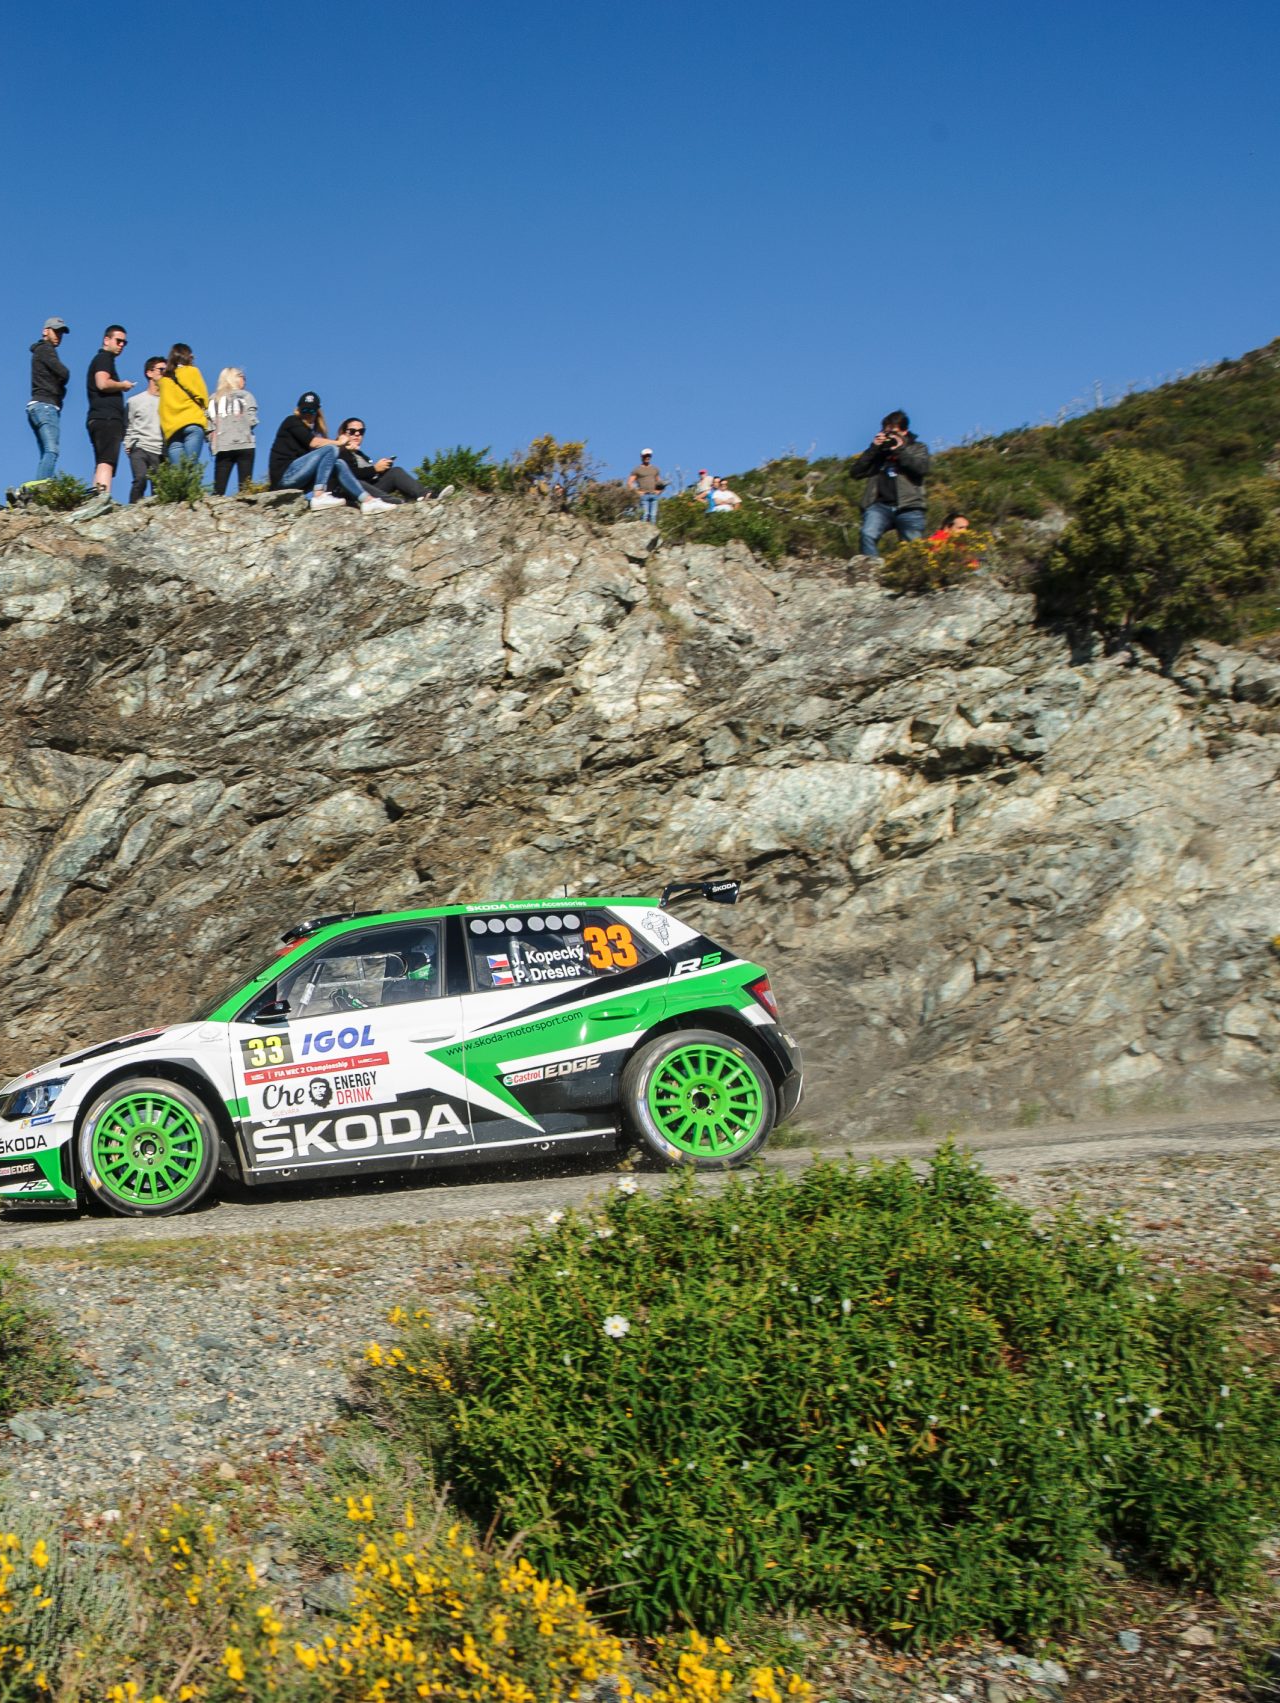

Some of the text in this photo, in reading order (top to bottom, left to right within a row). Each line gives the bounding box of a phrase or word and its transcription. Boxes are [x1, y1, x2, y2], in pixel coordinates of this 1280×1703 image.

[542, 900, 587, 908] Accessories
[512, 944, 585, 966] J. Kopecký
[583, 924, 638, 969] 33
[515, 963, 582, 983] P. Dresler
[673, 951, 722, 976] R5
[301, 1024, 375, 1056] IGOL
[446, 1010, 584, 1057] www.skoda-motorsport.com
[248, 1035, 285, 1067] 33
[274, 1070, 286, 1078] FIA
[286, 1068, 300, 1076] WRC
[306, 1060, 348, 1073] Championship
[333, 1070, 377, 1091] ENERGY
[513, 1054, 602, 1085] Castrol EDGE
[262, 1084, 305, 1110] Che
[336, 1087, 374, 1105] DRINK
[252, 1103, 469, 1163] ŠKODA
[11, 1163, 36, 1174] EDGE
[20, 1180, 47, 1191] R5
